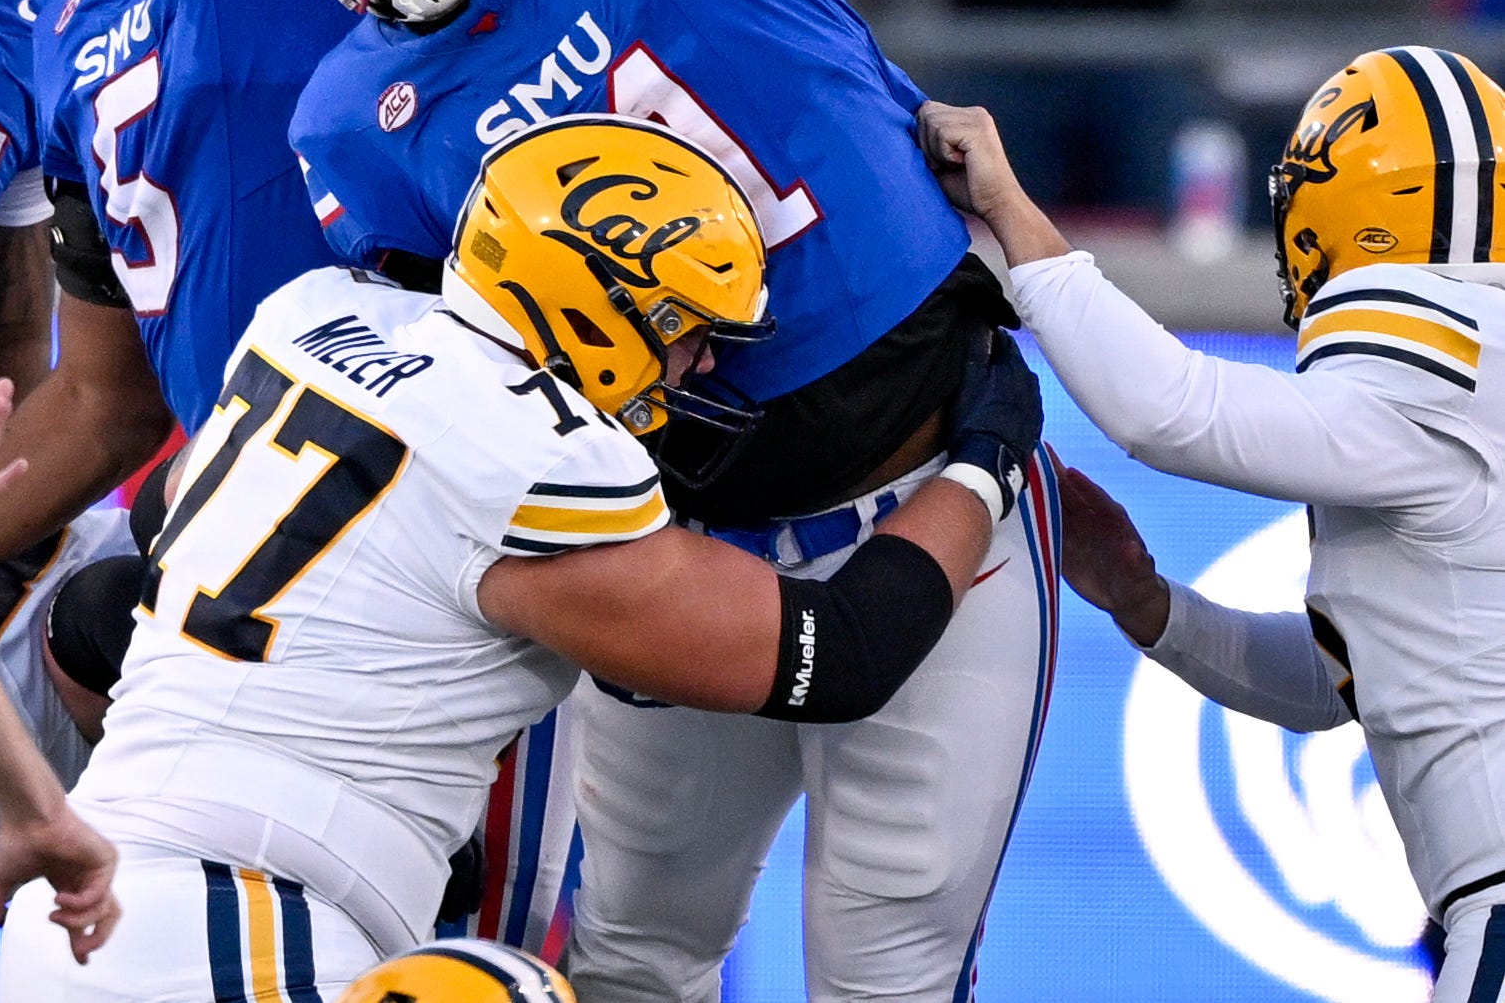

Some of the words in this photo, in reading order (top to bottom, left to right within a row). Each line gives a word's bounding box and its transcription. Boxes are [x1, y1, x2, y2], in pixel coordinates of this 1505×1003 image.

[384, 85, 411, 129] ACC
[475, 10, 612, 145] SMU
[92, 48, 182, 319] 5
[541, 174, 702, 289] Cal
[1361, 233, 1392, 245] ACC
[292, 315, 435, 398] MILLER
[138, 344, 411, 663] 77
